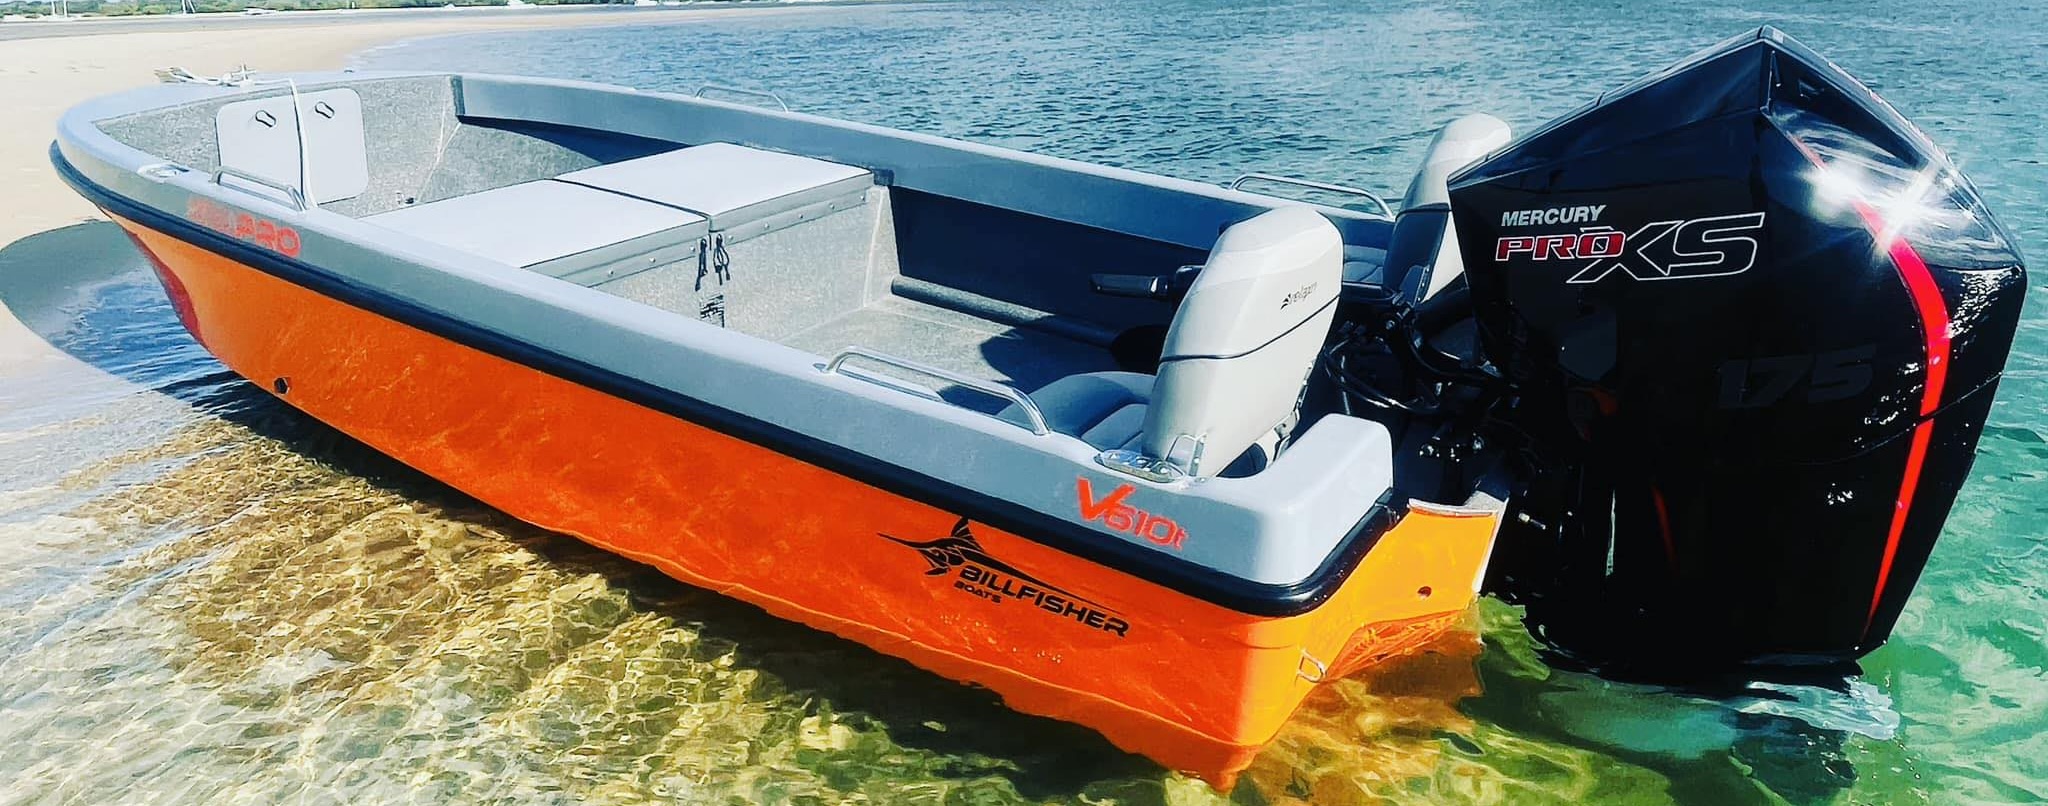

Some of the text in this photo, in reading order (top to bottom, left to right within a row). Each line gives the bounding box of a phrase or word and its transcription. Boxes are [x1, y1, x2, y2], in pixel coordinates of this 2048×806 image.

[1495, 212, 1765, 283] PRO XS
[1501, 205, 1606, 226] MERCURY
[1717, 343, 1877, 409] 175
[954, 580, 1003, 604] BOATS
[958, 564, 1130, 637] BILLFISHER
